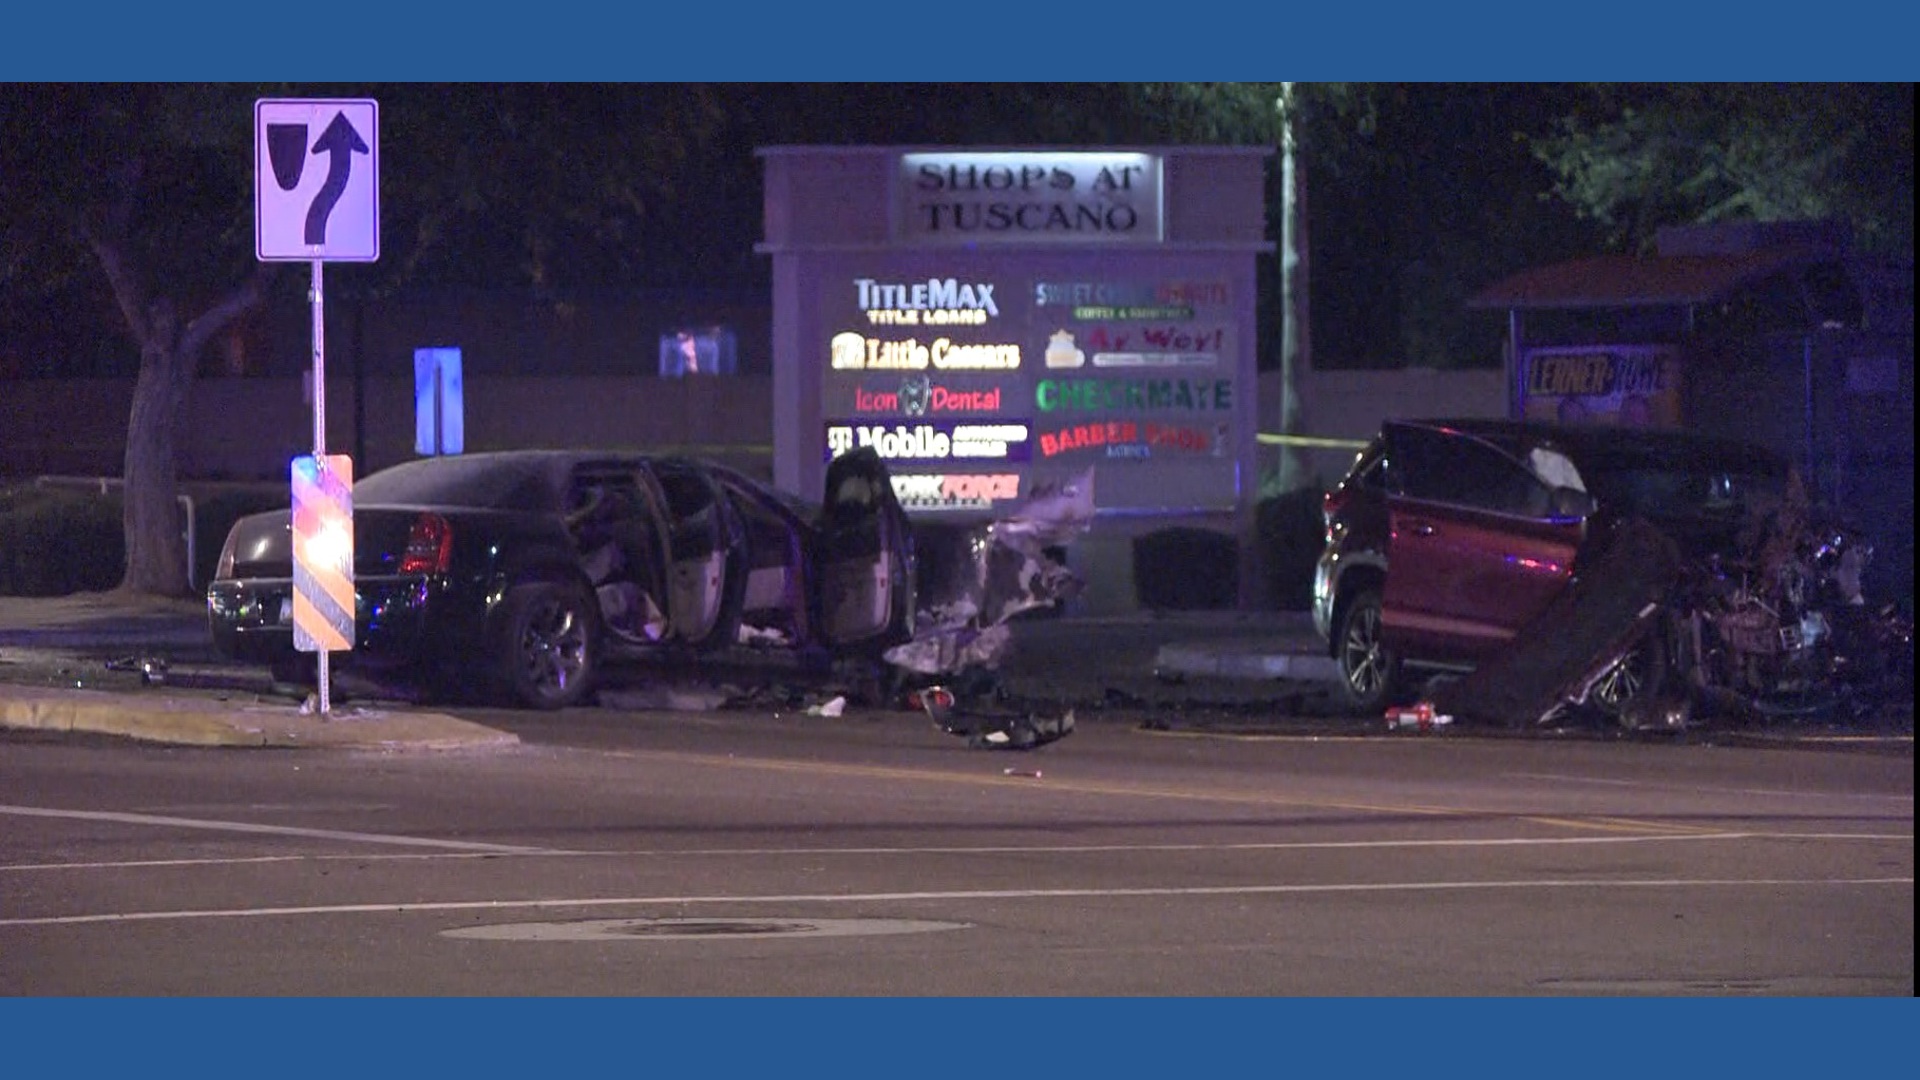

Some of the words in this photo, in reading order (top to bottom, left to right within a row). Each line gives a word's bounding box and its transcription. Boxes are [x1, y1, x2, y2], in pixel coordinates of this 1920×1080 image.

[918, 163, 1076, 190] SHOPS
[1092, 163, 1142, 190] AT
[921, 203, 1137, 231] TUSCANO
[867, 309, 918, 325] TITLE
[923, 309, 987, 325] LOANS
[866, 337, 929, 369] Little
[856, 388, 898, 410] Icon
[932, 386, 1000, 410] Dental
[1036, 379, 1231, 411] CHECKMATE
[856, 425, 951, 458] Mobile
[1040, 422, 1137, 457] BARBER
[889, 475, 1020, 499] ORKFORCE
